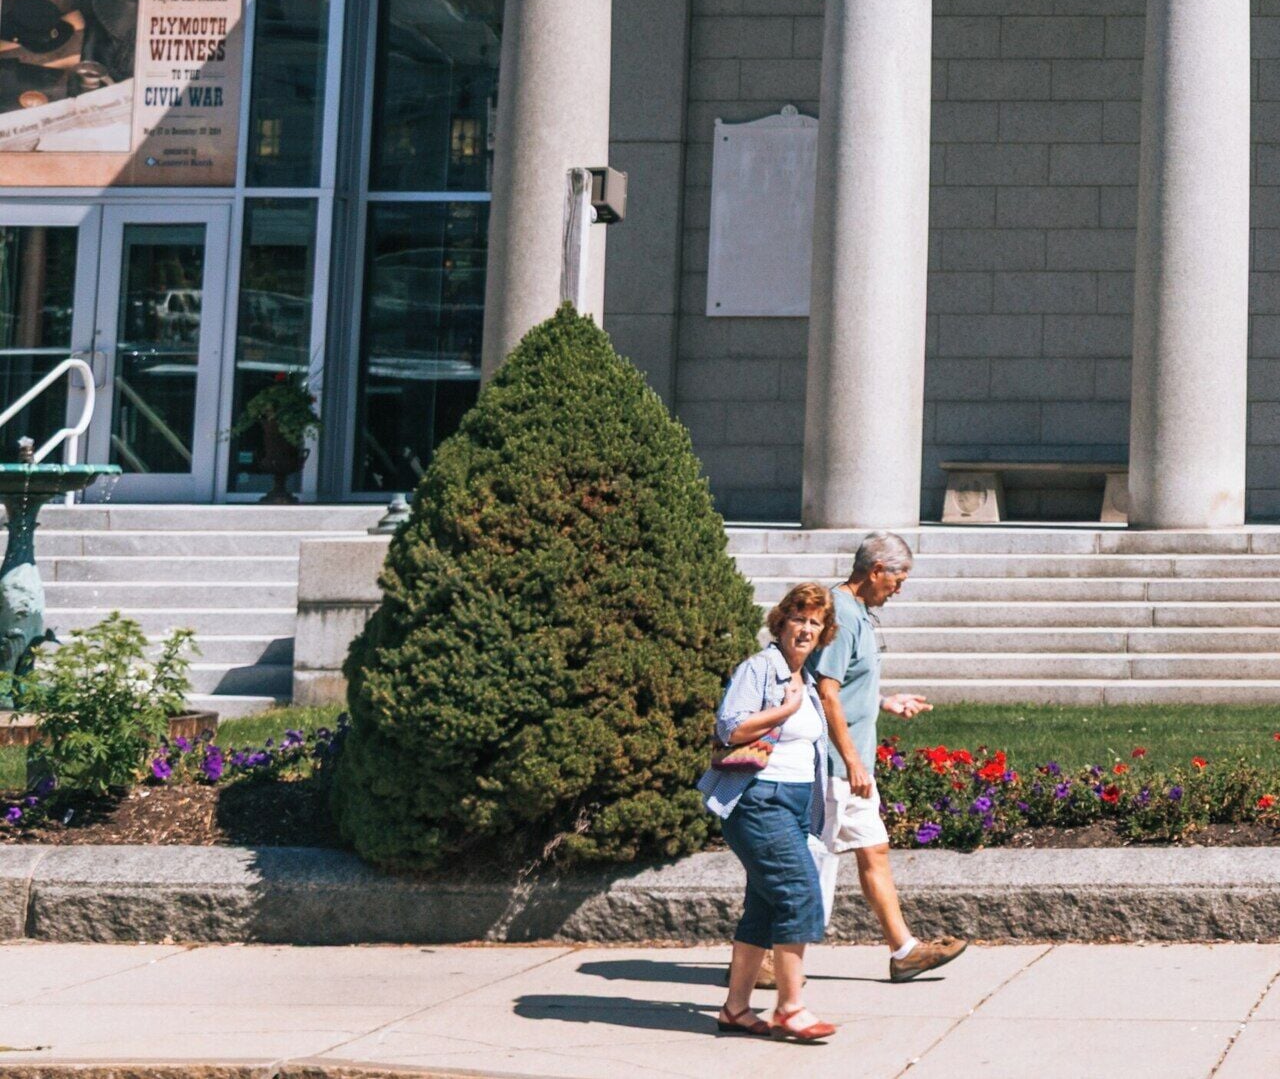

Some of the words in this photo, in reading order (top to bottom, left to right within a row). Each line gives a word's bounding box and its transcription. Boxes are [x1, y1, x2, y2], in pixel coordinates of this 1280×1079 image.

[150, 16, 228, 36] PLYMOUTH
[150, 39, 227, 61] WITNESS
[171, 69, 181, 80] TO
[184, 69, 201, 80] THE
[145, 87, 182, 107] CIVIL
[188, 87, 224, 107] WAR
